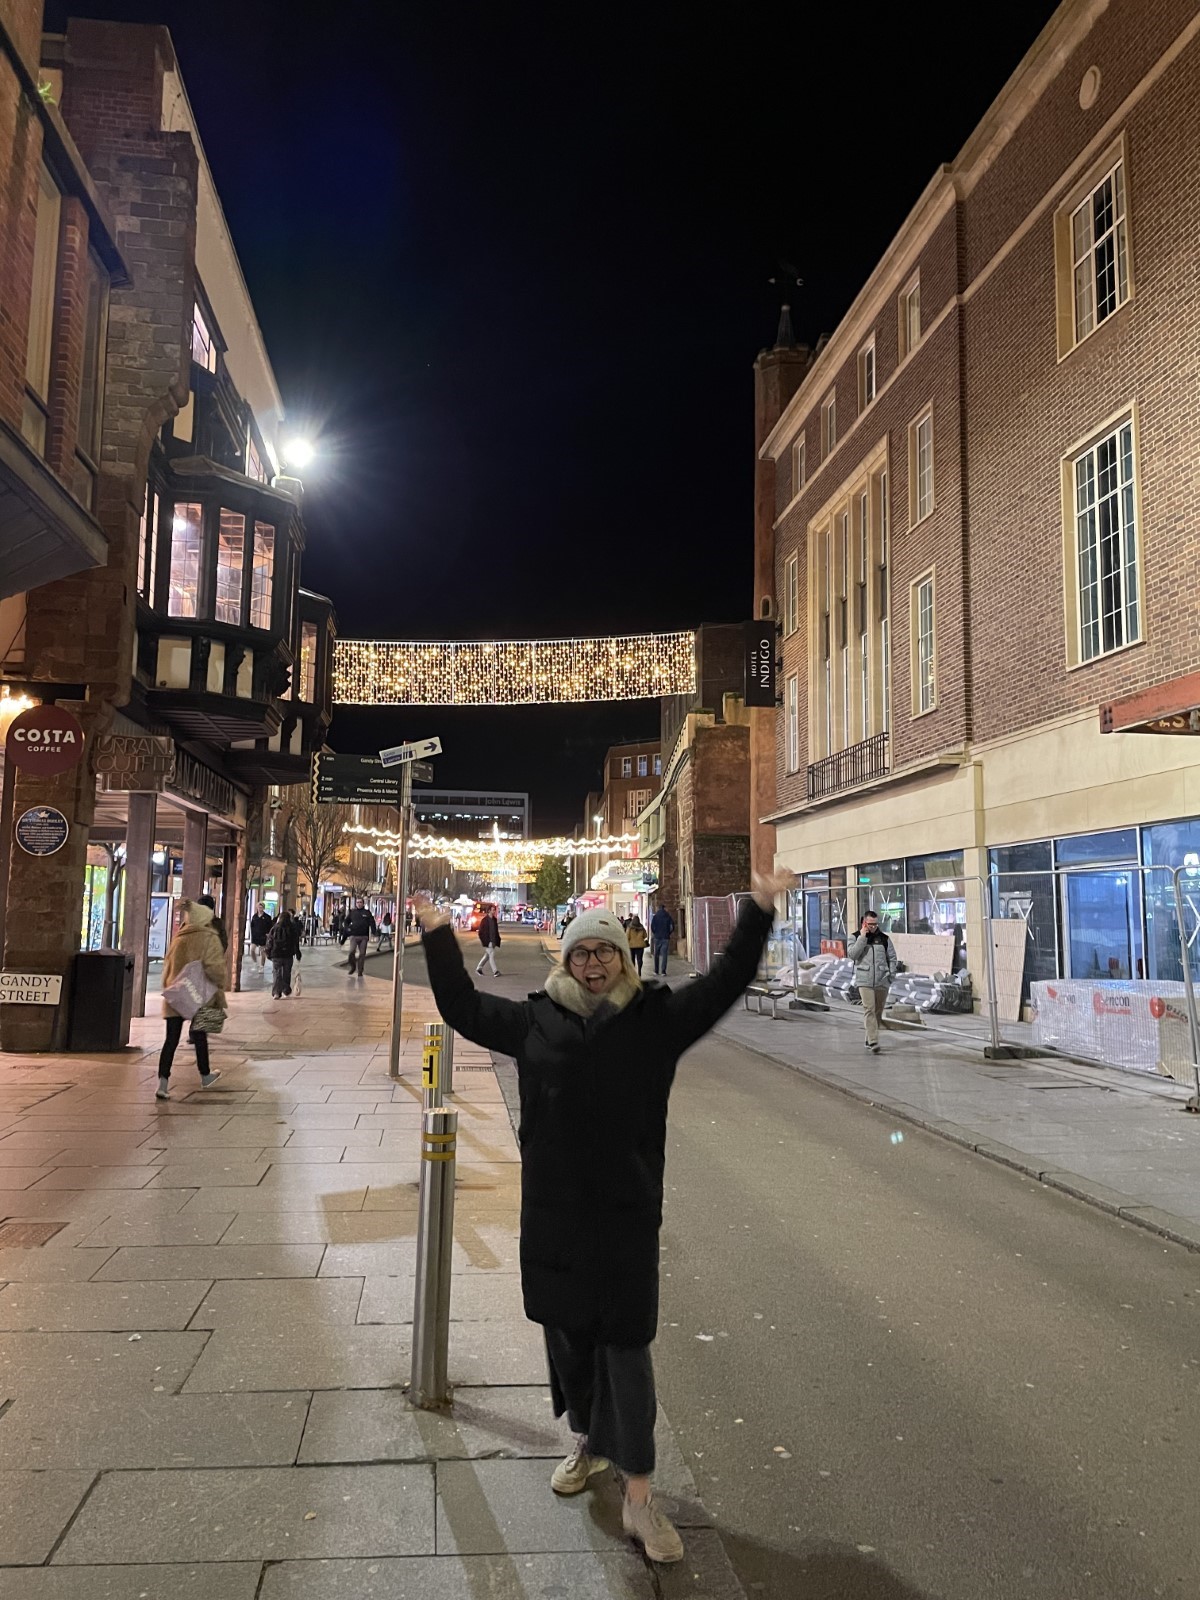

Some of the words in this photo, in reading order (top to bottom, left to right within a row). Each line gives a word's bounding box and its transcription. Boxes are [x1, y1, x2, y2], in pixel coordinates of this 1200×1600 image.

[760, 639, 770, 688] INDIGO
[13, 728, 76, 745] COSTA
[27, 745, 62, 753] COFFEE
[97, 737, 169, 755] URBAN
[96, 755, 170, 772] OUTFIT
[101, 772, 142, 790] TERS
[485, 797, 501, 806] John
[502, 798, 521, 806] Lewis
[0, 975, 52, 988] GANDY
[0, 989, 50, 1002] STREET
